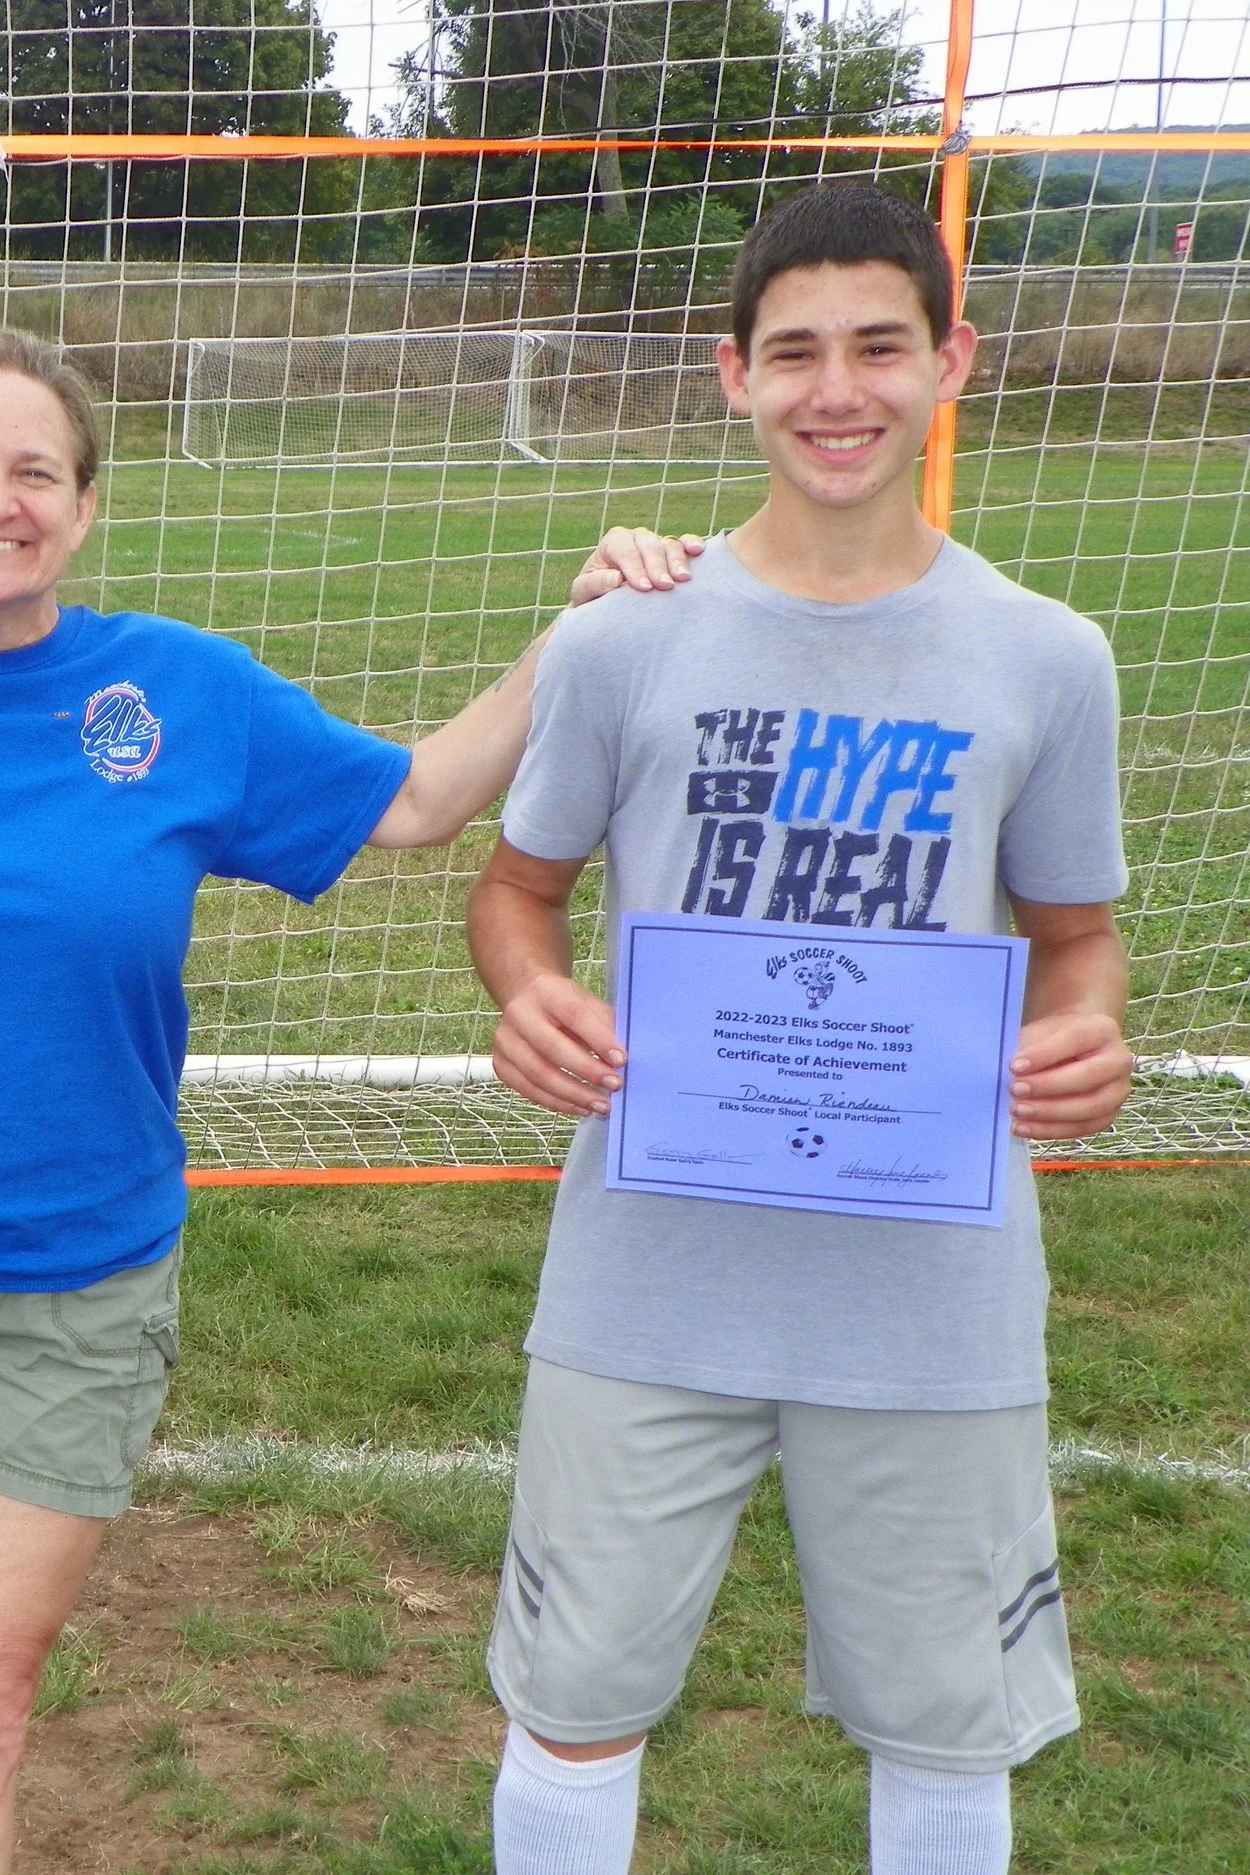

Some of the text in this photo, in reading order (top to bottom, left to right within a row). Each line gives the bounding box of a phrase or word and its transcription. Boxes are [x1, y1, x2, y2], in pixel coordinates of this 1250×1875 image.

[81, 694, 163, 756] Elks
[90, 758, 124, 783] Lodge
[695, 707, 975, 835] THE HYPE
[681, 816, 952, 931] IS REAL
[766, 947, 868, 984] Elks SOCCER SHOOT
[715, 1010, 787, 1026] 2022-2023
[791, 1017, 819, 1029] Elks
[822, 1019, 867, 1032] Soccer
[713, 1029, 913, 1053] Manchester Elks Lodge No. 1893
[717, 1047, 907, 1073] Certificate of Achievement
[777, 1068, 843, 1081] Presented to
[718, 1101, 740, 1111] Elks
[742, 1104, 775, 1115] Soccer
[814, 1110, 841, 1121] Local
[844, 1113, 901, 1125] Participant
